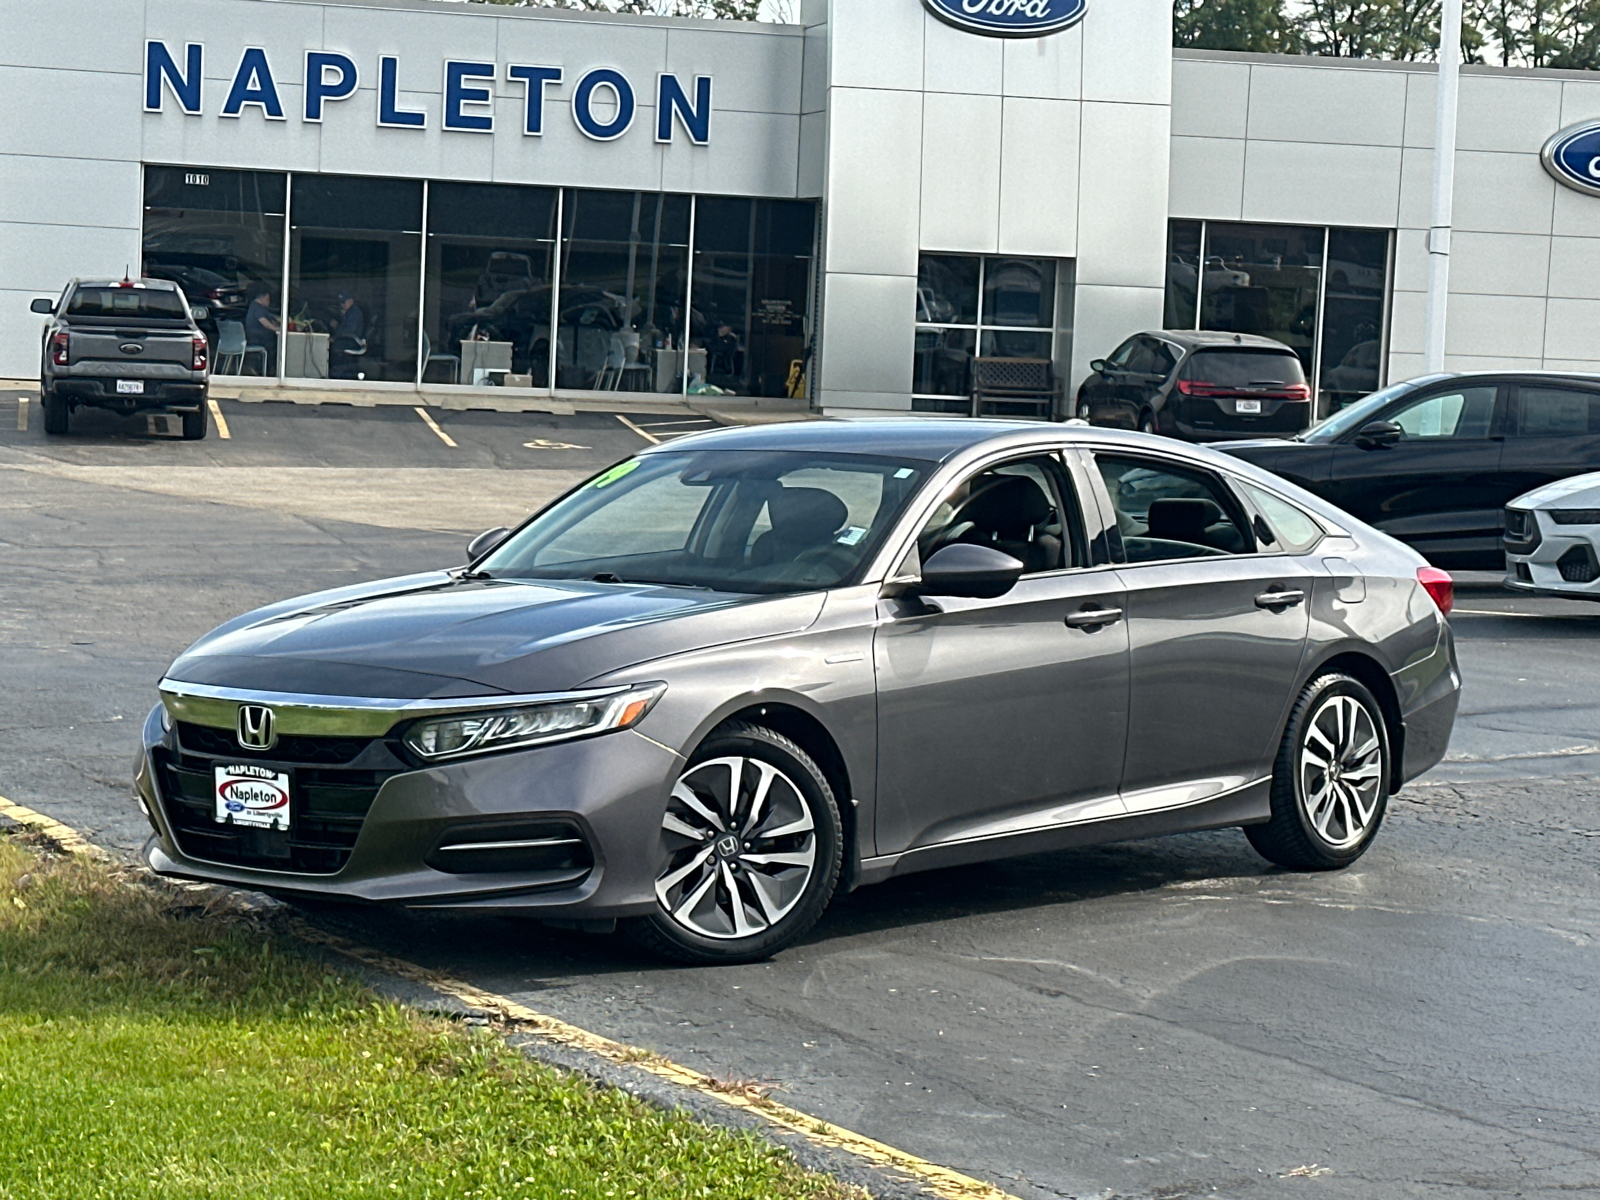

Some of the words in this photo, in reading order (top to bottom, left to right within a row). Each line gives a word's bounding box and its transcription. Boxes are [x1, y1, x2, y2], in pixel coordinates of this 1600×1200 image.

[143, 38, 713, 146] NAPLETON
[186, 173, 210, 185] 1010
[227, 765, 275, 779] NAPLETON
[230, 784, 277, 804] Napleton
